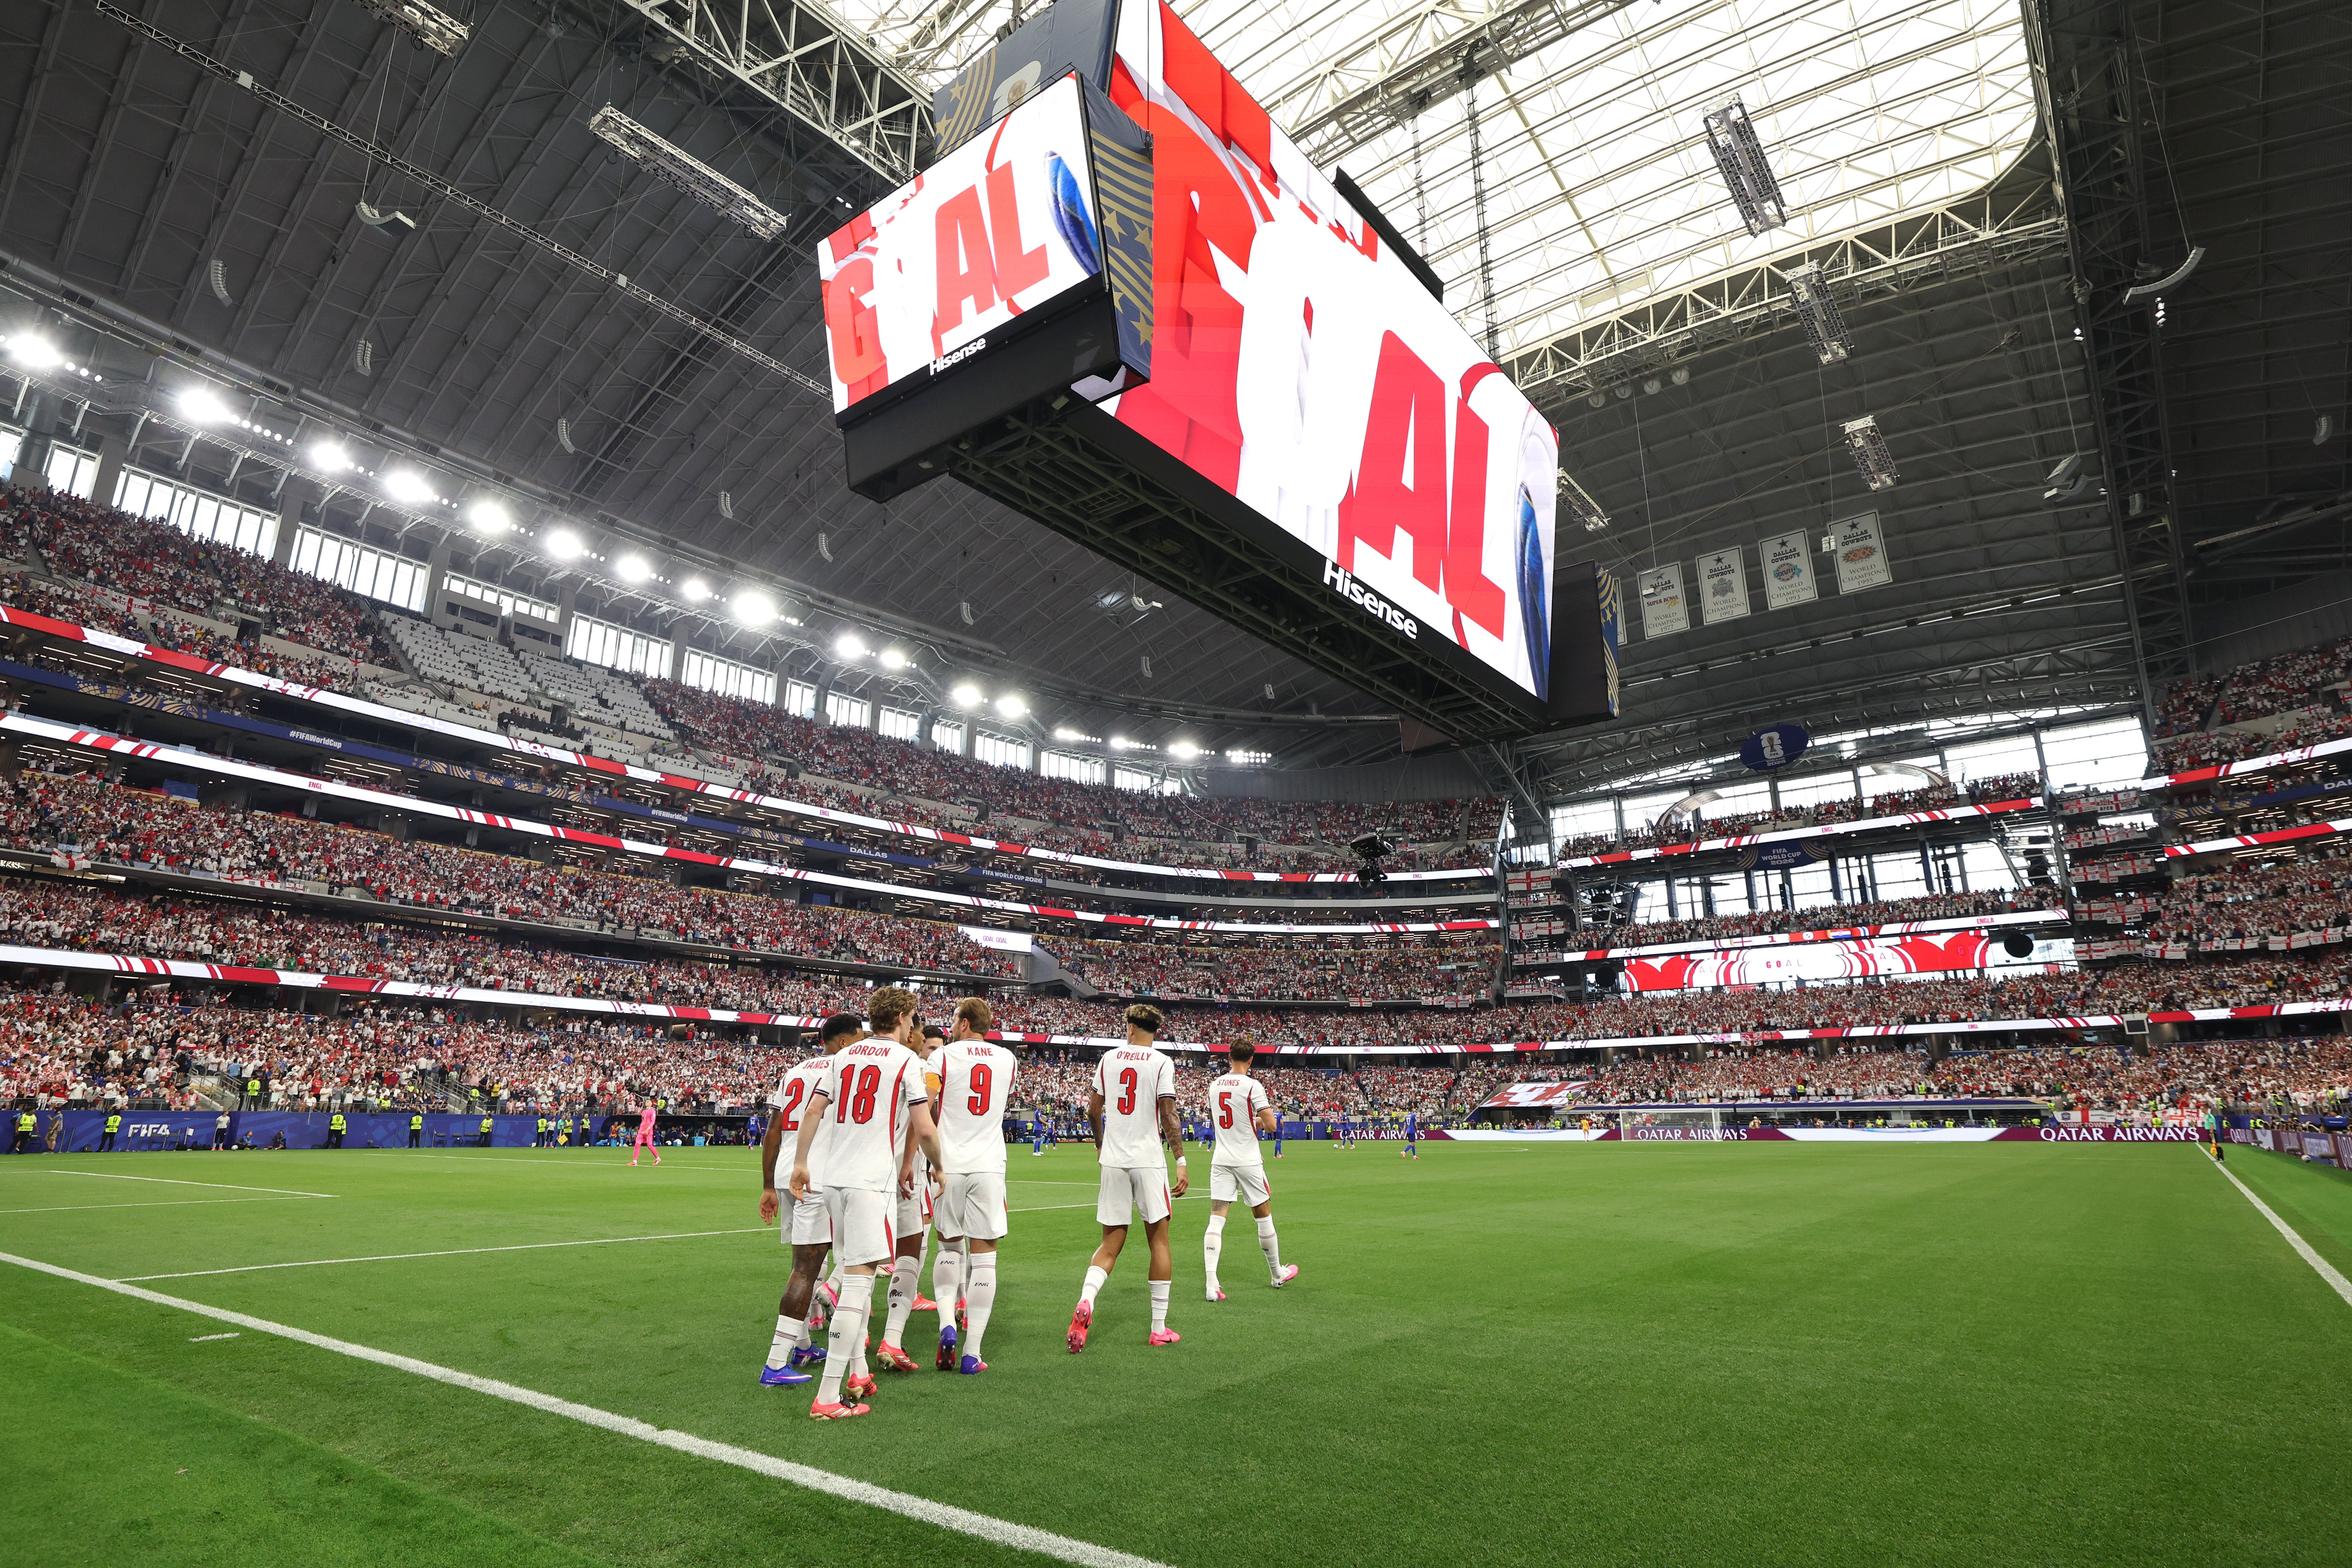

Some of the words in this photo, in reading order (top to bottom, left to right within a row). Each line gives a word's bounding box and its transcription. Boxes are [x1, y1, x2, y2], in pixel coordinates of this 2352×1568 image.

[929, 337, 986, 376] Hisense
[1843, 529, 1868, 540] DALLAS
[1841, 534, 1872, 547] COWBOYS
[1771, 552, 1800, 563] COWBOYS
[1773, 547, 1797, 557] DALLAS
[1707, 568, 1735, 579] COWBOYS
[1709, 564, 1732, 573] DALLAS
[1849, 564, 1876, 574] WORLD
[1842, 568, 1885, 583] CHAMPIONS
[1650, 579, 1671, 588] DALLAS
[1777, 581, 1803, 591] WORLD
[1857, 577, 1873, 586] 1995
[1771, 586, 1812, 599] CHAMPIONS
[116, 599, 143, 609] CHELSEA
[1323, 560, 1417, 640] Hisense
[1713, 597, 1737, 606] WORLD
[1707, 601, 1745, 615] CHAMPIONS
[1654, 612, 1677, 621] WORLD
[1720, 610, 1734, 618] 1992
[1648, 616, 1685, 629] CHAMPIONS
[394, 710, 444, 729] GOAL
[289, 730, 342, 749] #FIFAWorldCup
[517, 740, 561, 757] GOAL
[308, 781, 323, 790] ENGL
[651, 810, 688, 822] #FIFAWorldCup
[850, 847, 888, 858] DALLAS
[1766, 959, 1803, 968] GOAL
[848, 1045, 891, 1057] GORDON
[967, 1047, 993, 1056] KANE
[1117, 1051, 1152, 1061] O'REILLY
[802, 1059, 830, 1070] JAMES
[837, 1064, 881, 1124] 18
[967, 1064, 992, 1116] 9
[1117, 1068, 1138, 1115] 3
[1219, 1092, 1234, 1129] 5
[1405, 1117, 1411, 1126] 17
[128, 1124, 170, 1137] FIFA
[1379, 1130, 1426, 1140] AIRWYS
[1637, 1129, 1682, 1140] QATAR
[1687, 1128, 1748, 1140] AIRWAYS
[2040, 1128, 2106, 1142] QATAR
[2113, 1127, 2200, 1141] AIRWAYS
